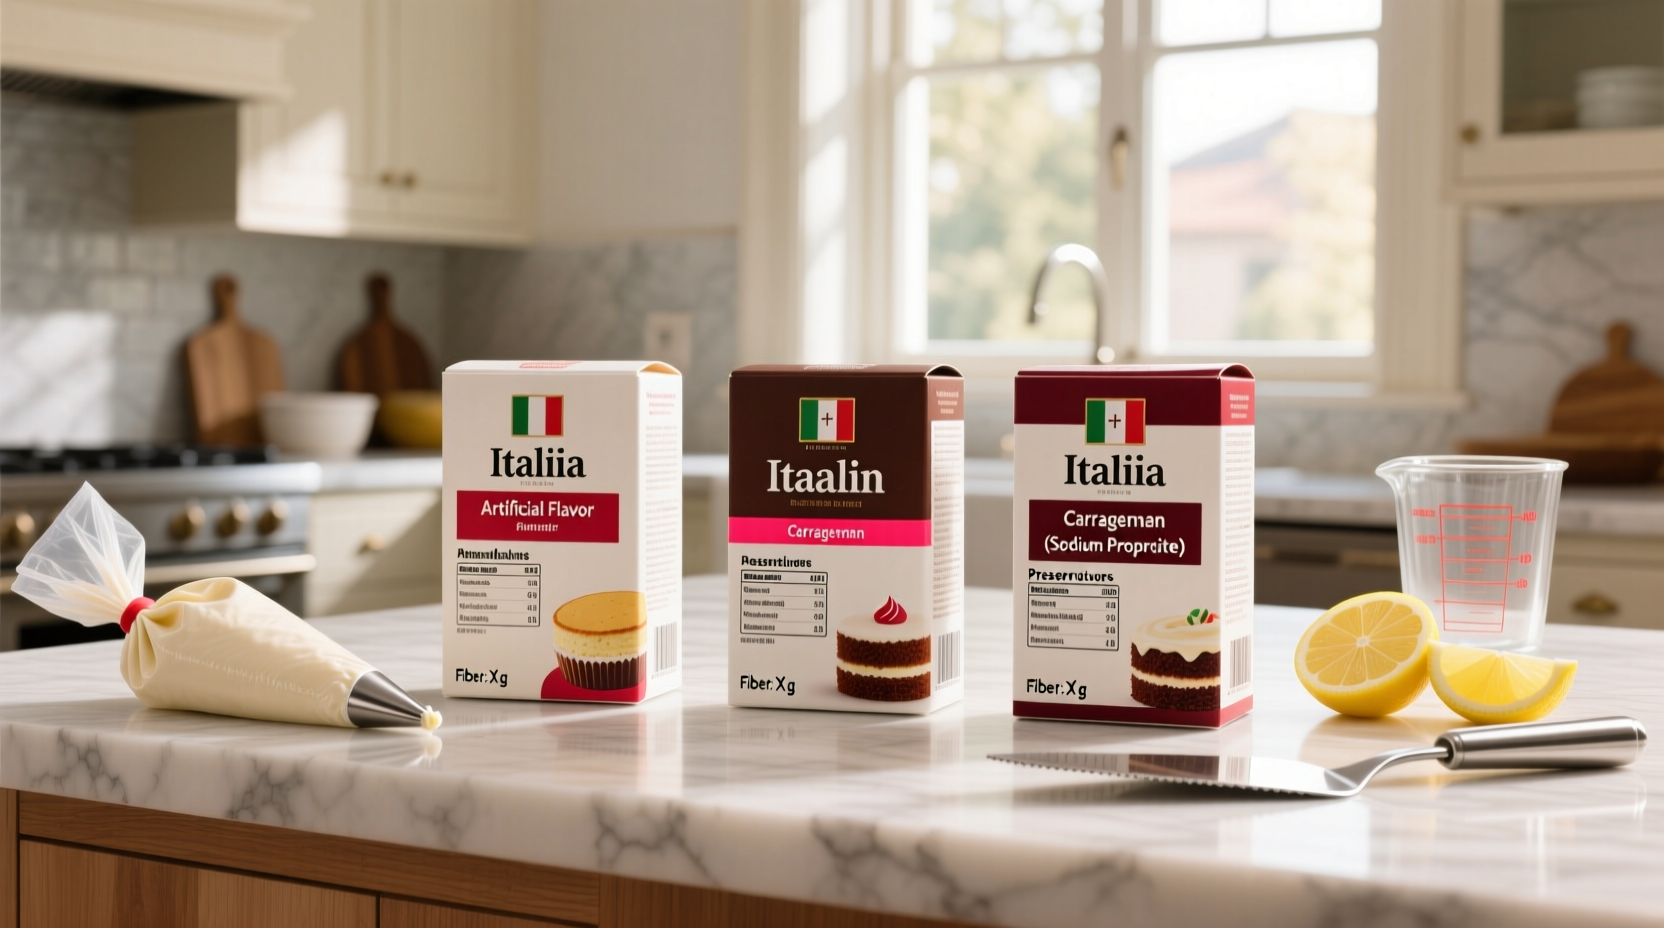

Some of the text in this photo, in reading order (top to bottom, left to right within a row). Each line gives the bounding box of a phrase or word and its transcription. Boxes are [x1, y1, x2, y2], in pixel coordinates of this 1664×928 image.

[490, 447, 587, 478] Italiia
[766, 459, 885, 494] Itaalin
[1063, 454, 1167, 487] Italiia
[480, 500, 595, 518] Artificial Flavor
[1044, 534, 1103, 555] (Sodium
